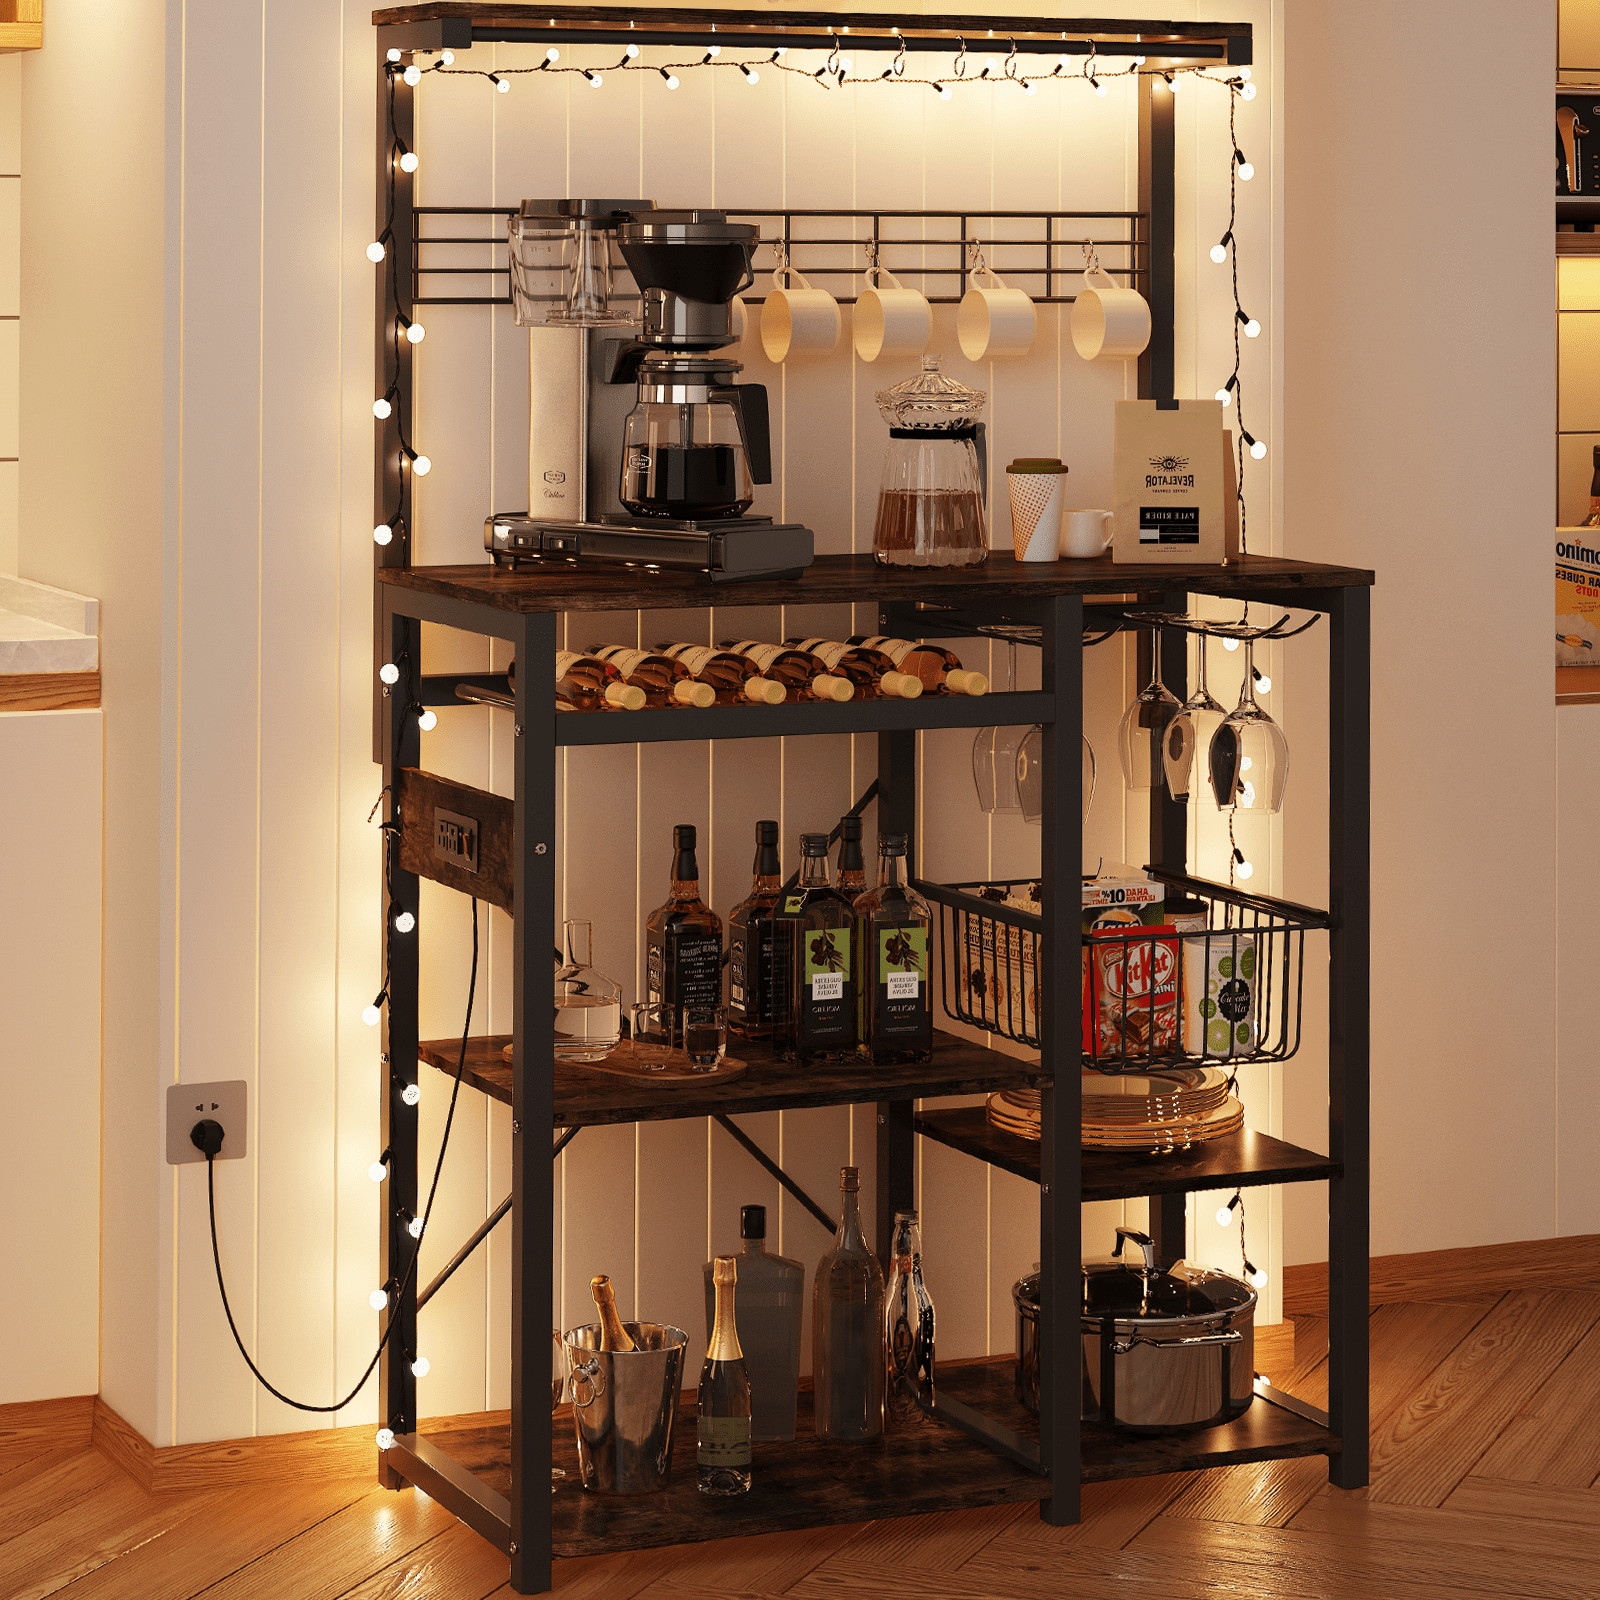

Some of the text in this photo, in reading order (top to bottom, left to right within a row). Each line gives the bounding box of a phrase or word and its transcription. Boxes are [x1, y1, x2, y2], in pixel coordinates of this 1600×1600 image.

[1126, 888, 1148, 896] DAHA
[964, 931, 994, 947] CHUKS
[1000, 929, 1028, 941] WHIE
